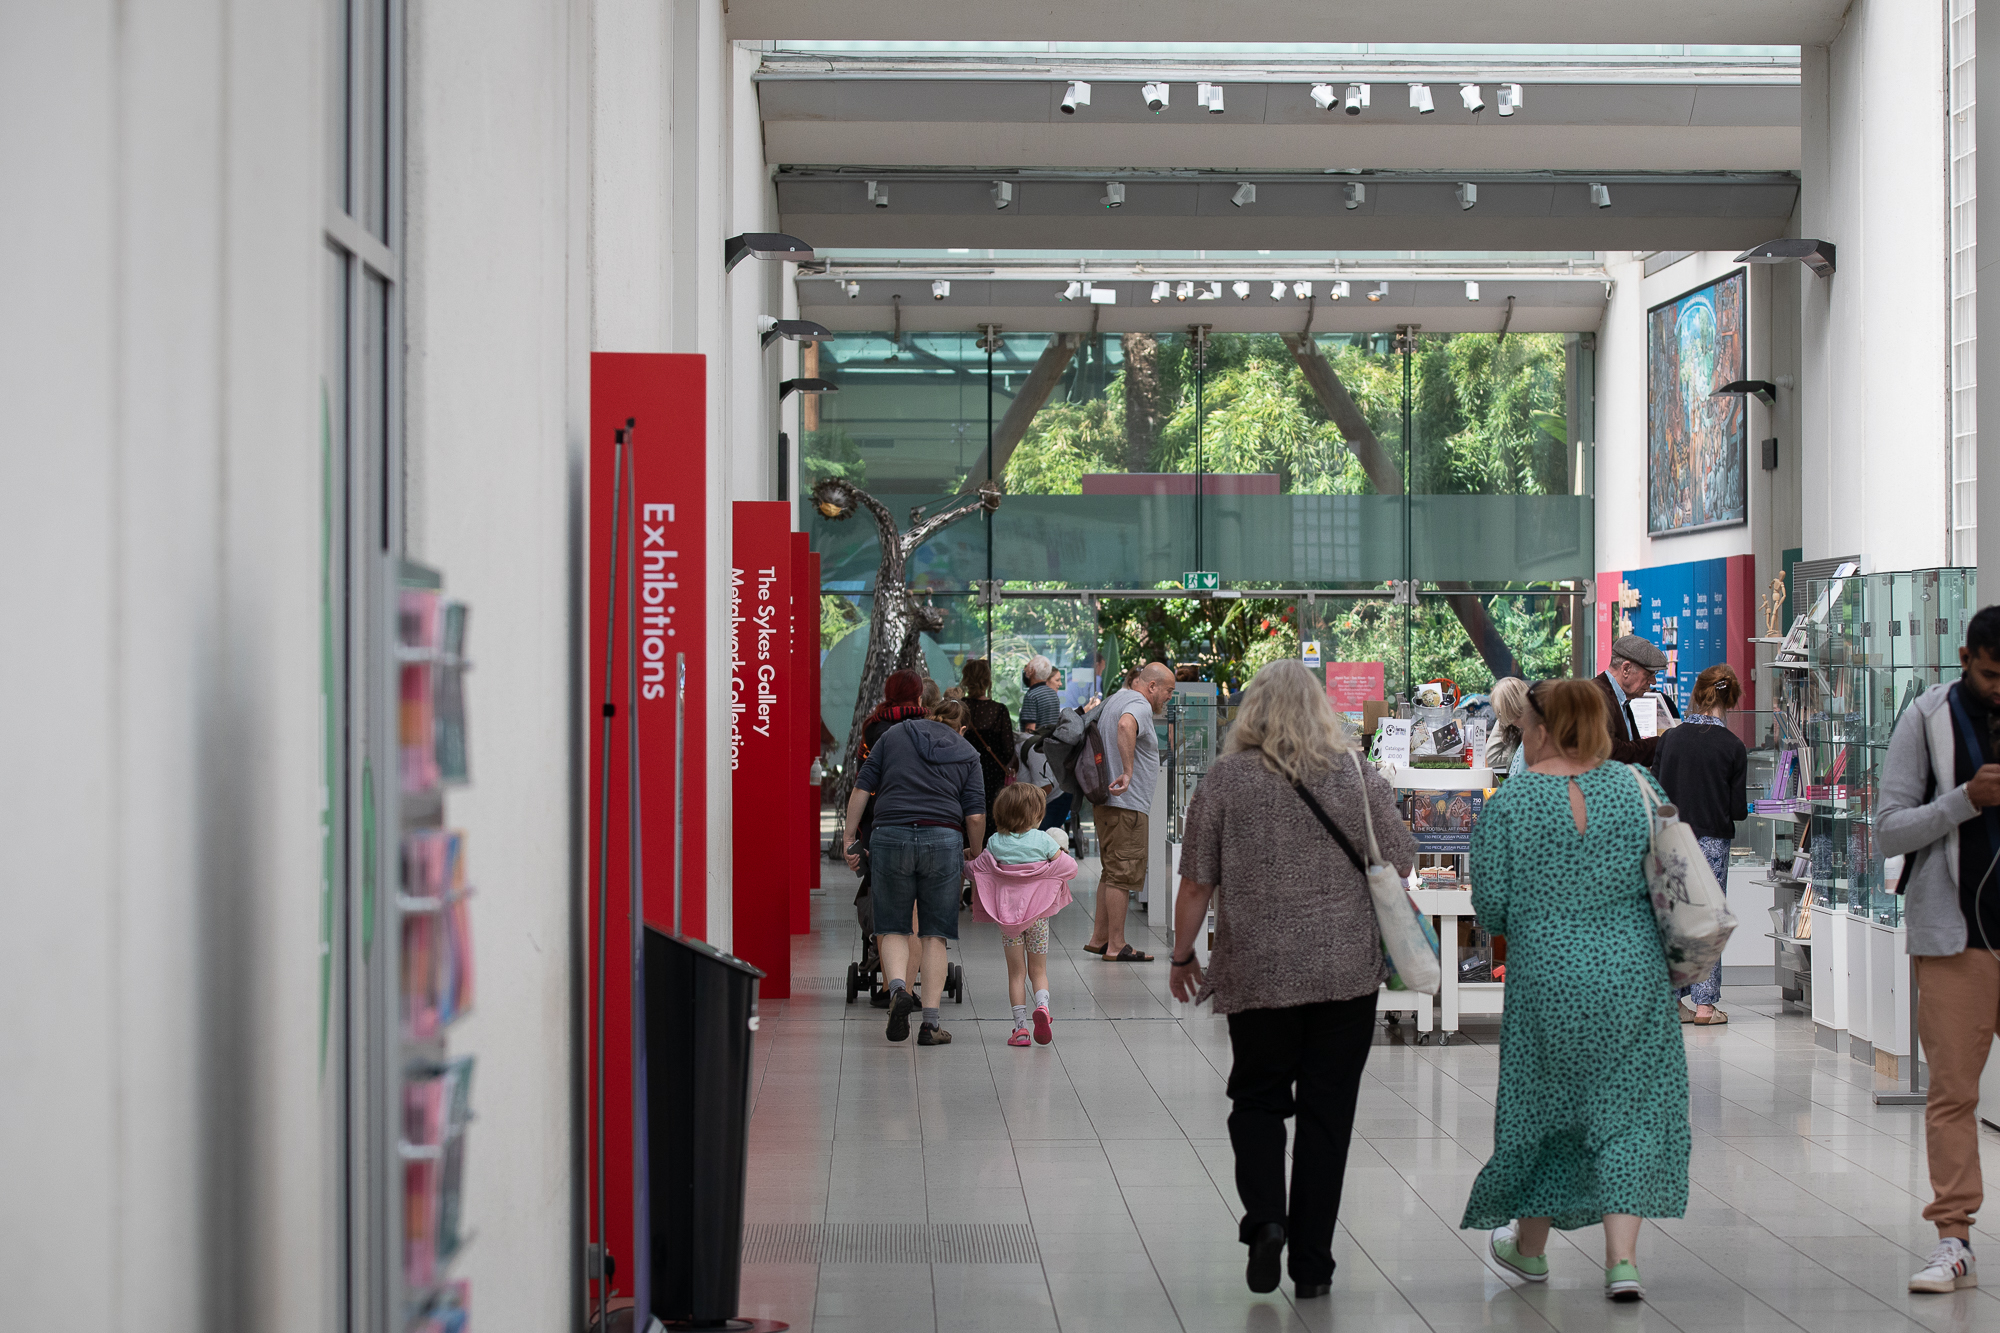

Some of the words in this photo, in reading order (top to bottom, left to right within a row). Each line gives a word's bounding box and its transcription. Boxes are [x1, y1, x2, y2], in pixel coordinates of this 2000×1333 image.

[642, 503, 678, 700] Exhibitions
[732, 568, 746, 672] Metalwork
[758, 566, 777, 601] The
[753, 605, 777, 660] Sykes
[732, 677, 746, 770] Collection
[753, 665, 777, 737] Gallery
